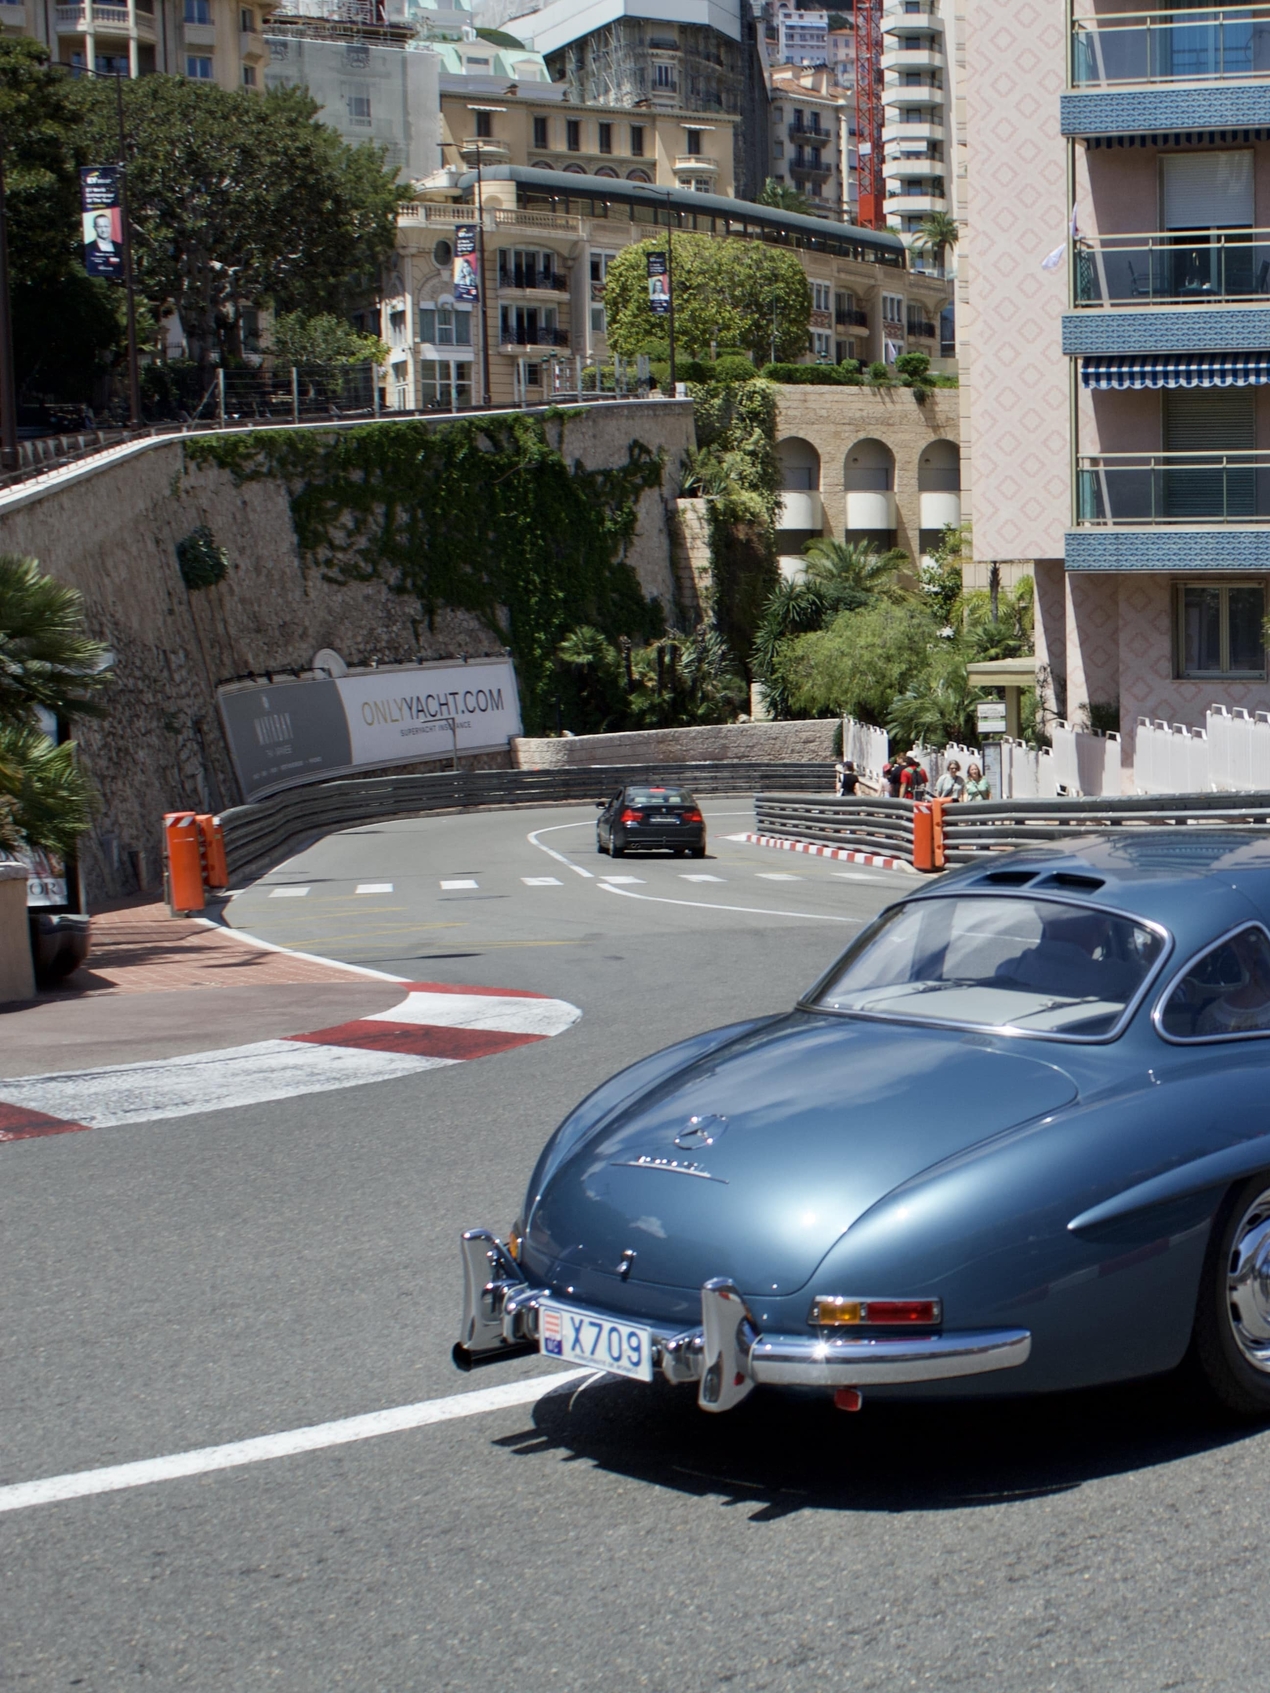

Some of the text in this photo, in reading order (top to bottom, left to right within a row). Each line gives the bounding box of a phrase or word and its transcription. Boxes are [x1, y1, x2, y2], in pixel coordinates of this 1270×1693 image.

[361, 688, 505, 726] ONLYYACHT.COM
[400, 725, 437, 737] SUPERYACHT
[570, 1316, 642, 1367] X709
